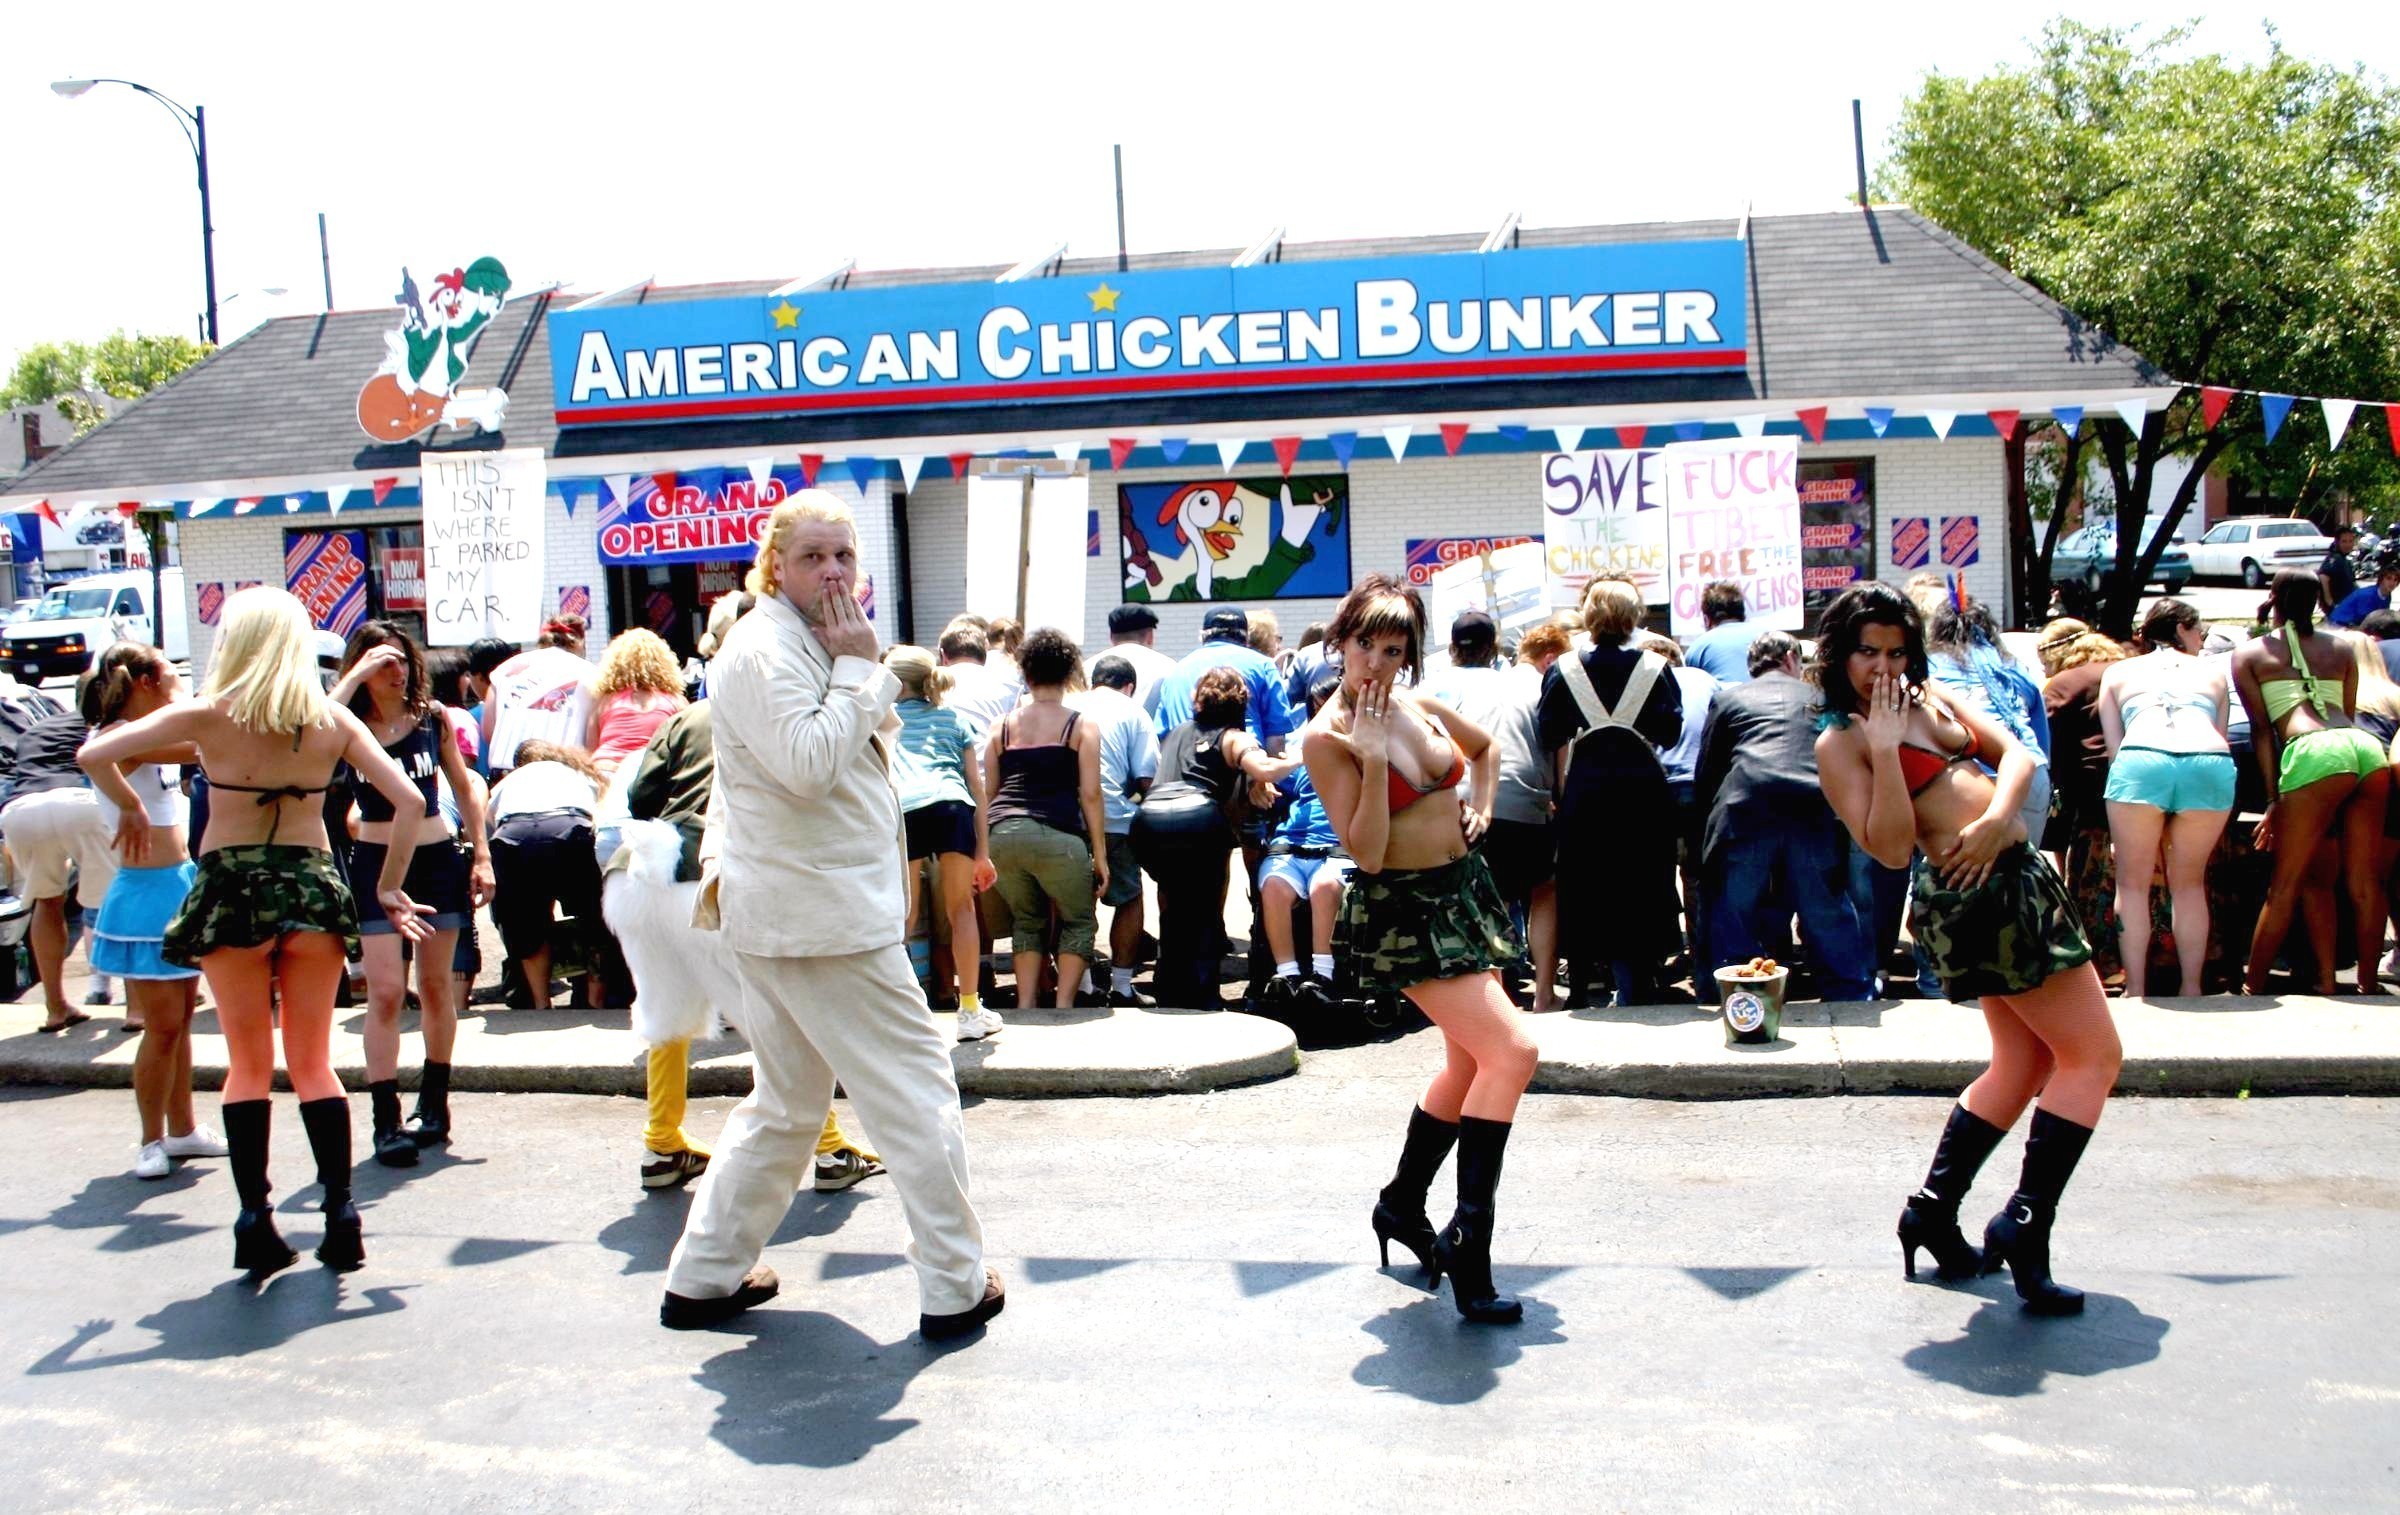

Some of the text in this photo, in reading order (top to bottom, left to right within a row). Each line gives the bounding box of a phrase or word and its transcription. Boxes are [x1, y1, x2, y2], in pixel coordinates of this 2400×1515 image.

[570, 278, 1725, 402] AMERICAN CHICKEN BUNKER
[432, 459, 501, 486] THIS
[1544, 451, 1663, 516] SAVE
[1683, 450, 1795, 499] FUCK
[453, 486, 516, 512] ISN'T
[432, 516, 513, 539] WHERE
[1569, 515, 1629, 543] THE
[1672, 503, 1796, 550] TIBET
[427, 541, 530, 568] I PARKED
[1437, 536, 1533, 562] GRA
[1548, 544, 1666, 576] CHICKENS
[1679, 544, 1799, 578] FREE THE
[390, 560, 418, 579] NOW
[447, 566, 481, 592] MY
[386, 580, 425, 599] HIRING
[435, 594, 511, 624] CAR.
